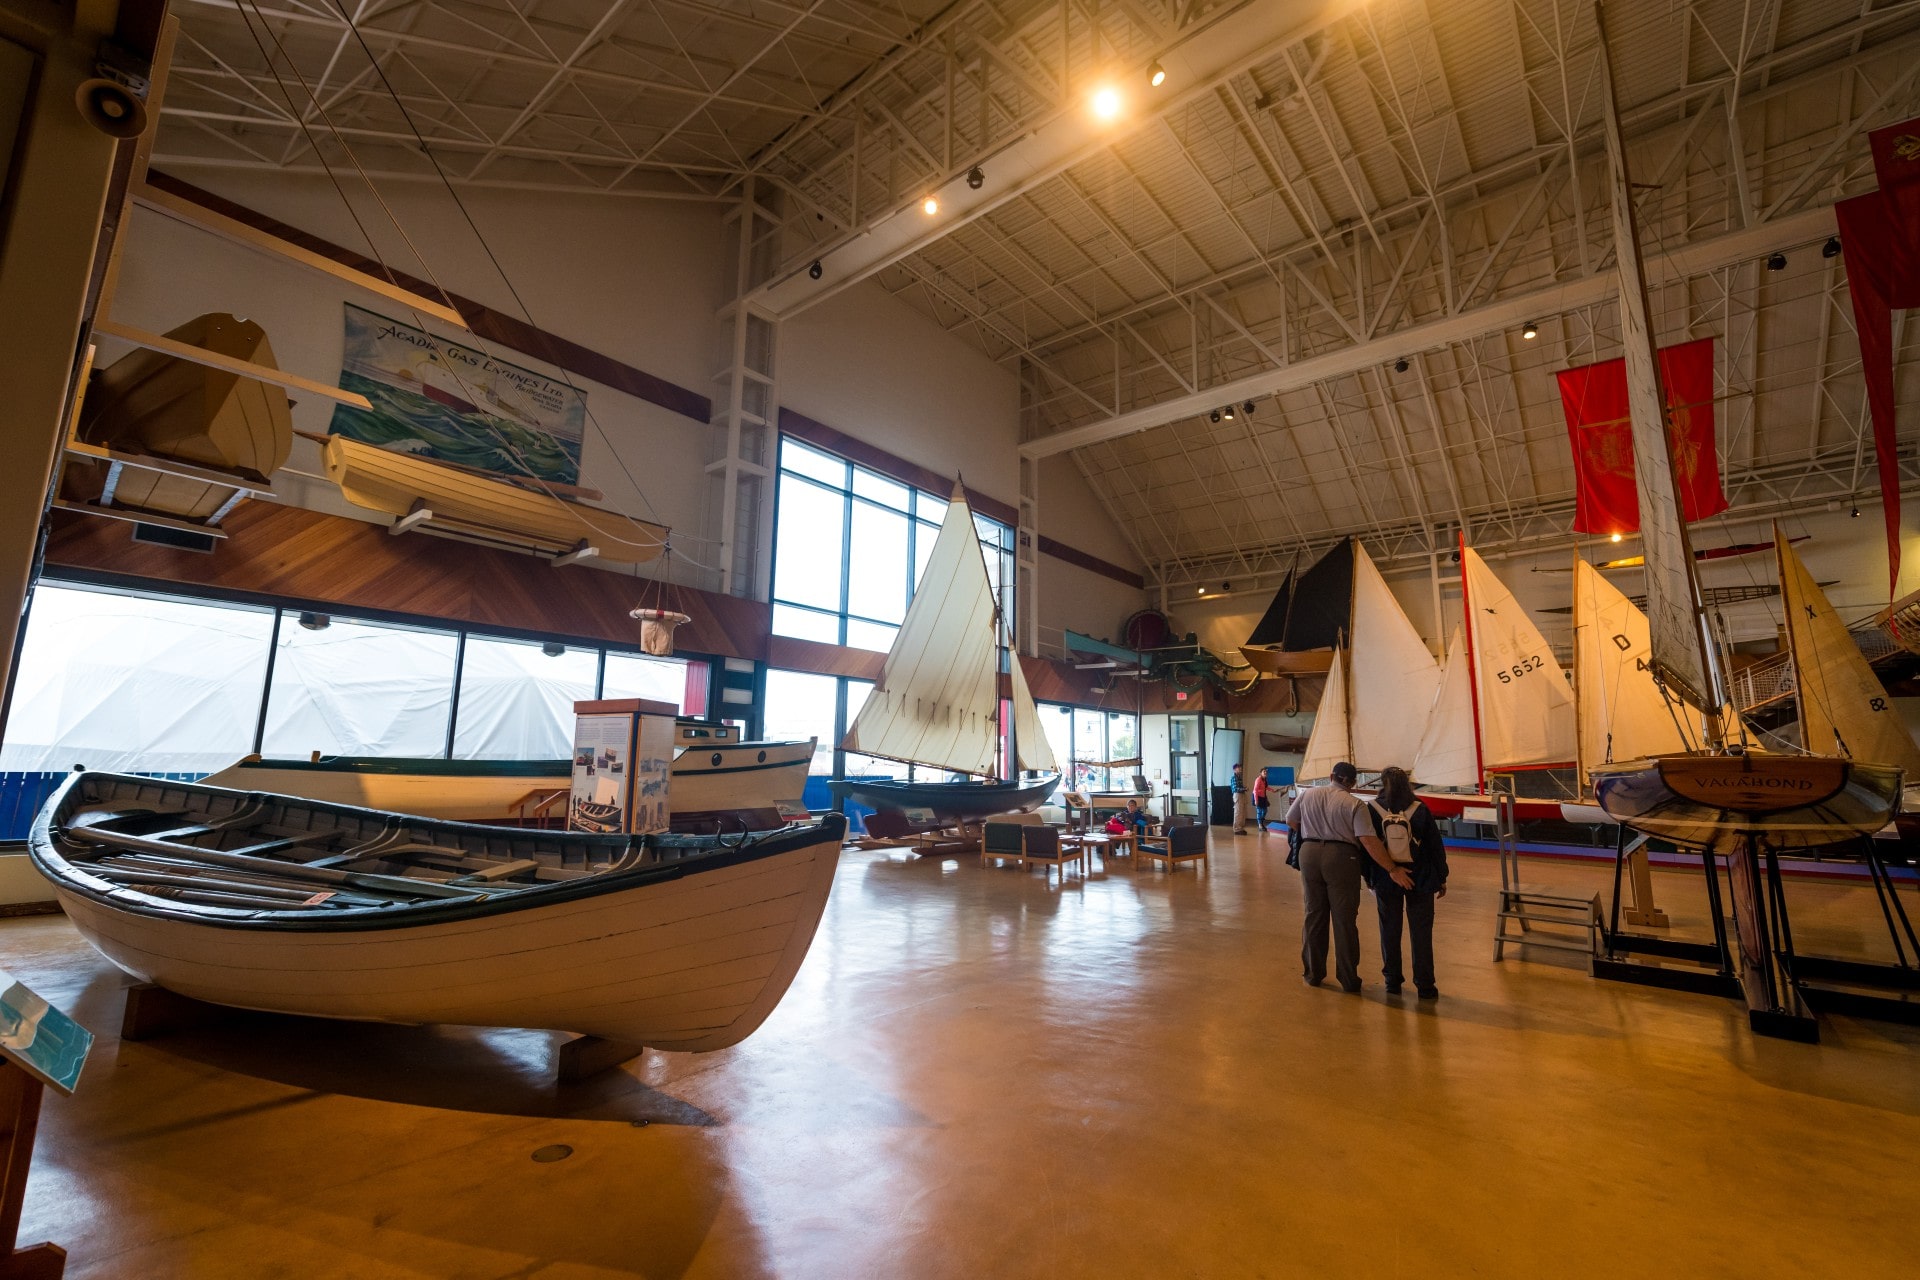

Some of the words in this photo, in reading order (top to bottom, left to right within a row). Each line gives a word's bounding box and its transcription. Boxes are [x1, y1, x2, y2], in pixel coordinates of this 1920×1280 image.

[377, 326, 439, 351] ACADI
[447, 347, 479, 366] GAS
[482, 361, 539, 388] ENGINES
[543, 382, 564, 398] LTD.
[515, 383, 564, 405] BRIDGEWATER
[1612, 634, 1631, 651] D
[1497, 655, 1544, 684] 5652
[1869, 698, 1889, 712] 82
[1694, 776, 1814, 791] VAGABOND
